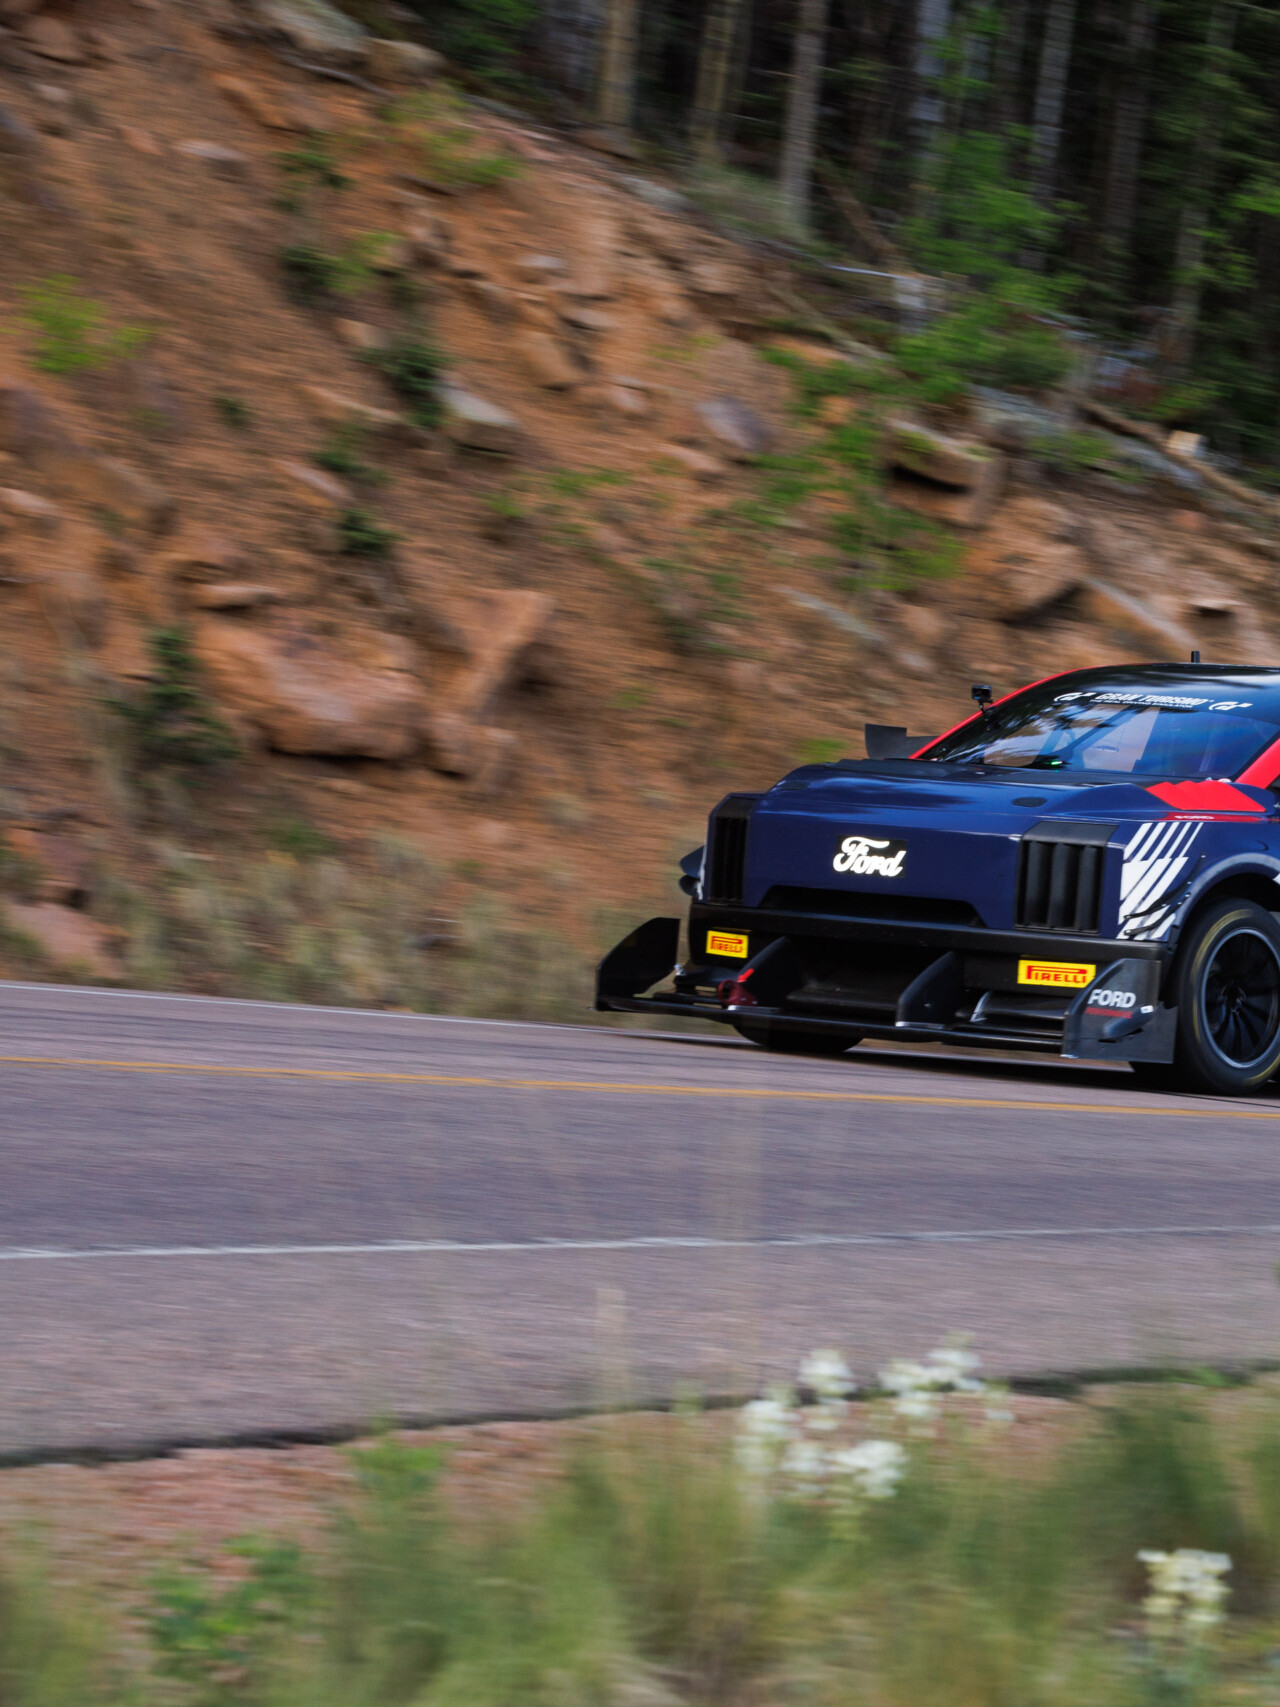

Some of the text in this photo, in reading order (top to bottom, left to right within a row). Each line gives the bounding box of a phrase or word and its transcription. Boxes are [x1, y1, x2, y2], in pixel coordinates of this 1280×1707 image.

[1094, 693, 1144, 702] GRAN
[1138, 695, 1209, 706] TURISMO
[833, 837, 906, 877] Ford
[711, 936, 744, 954] PIRELLI
[1026, 965, 1088, 983] PIRELLI
[1087, 989, 1137, 1008] FORD
